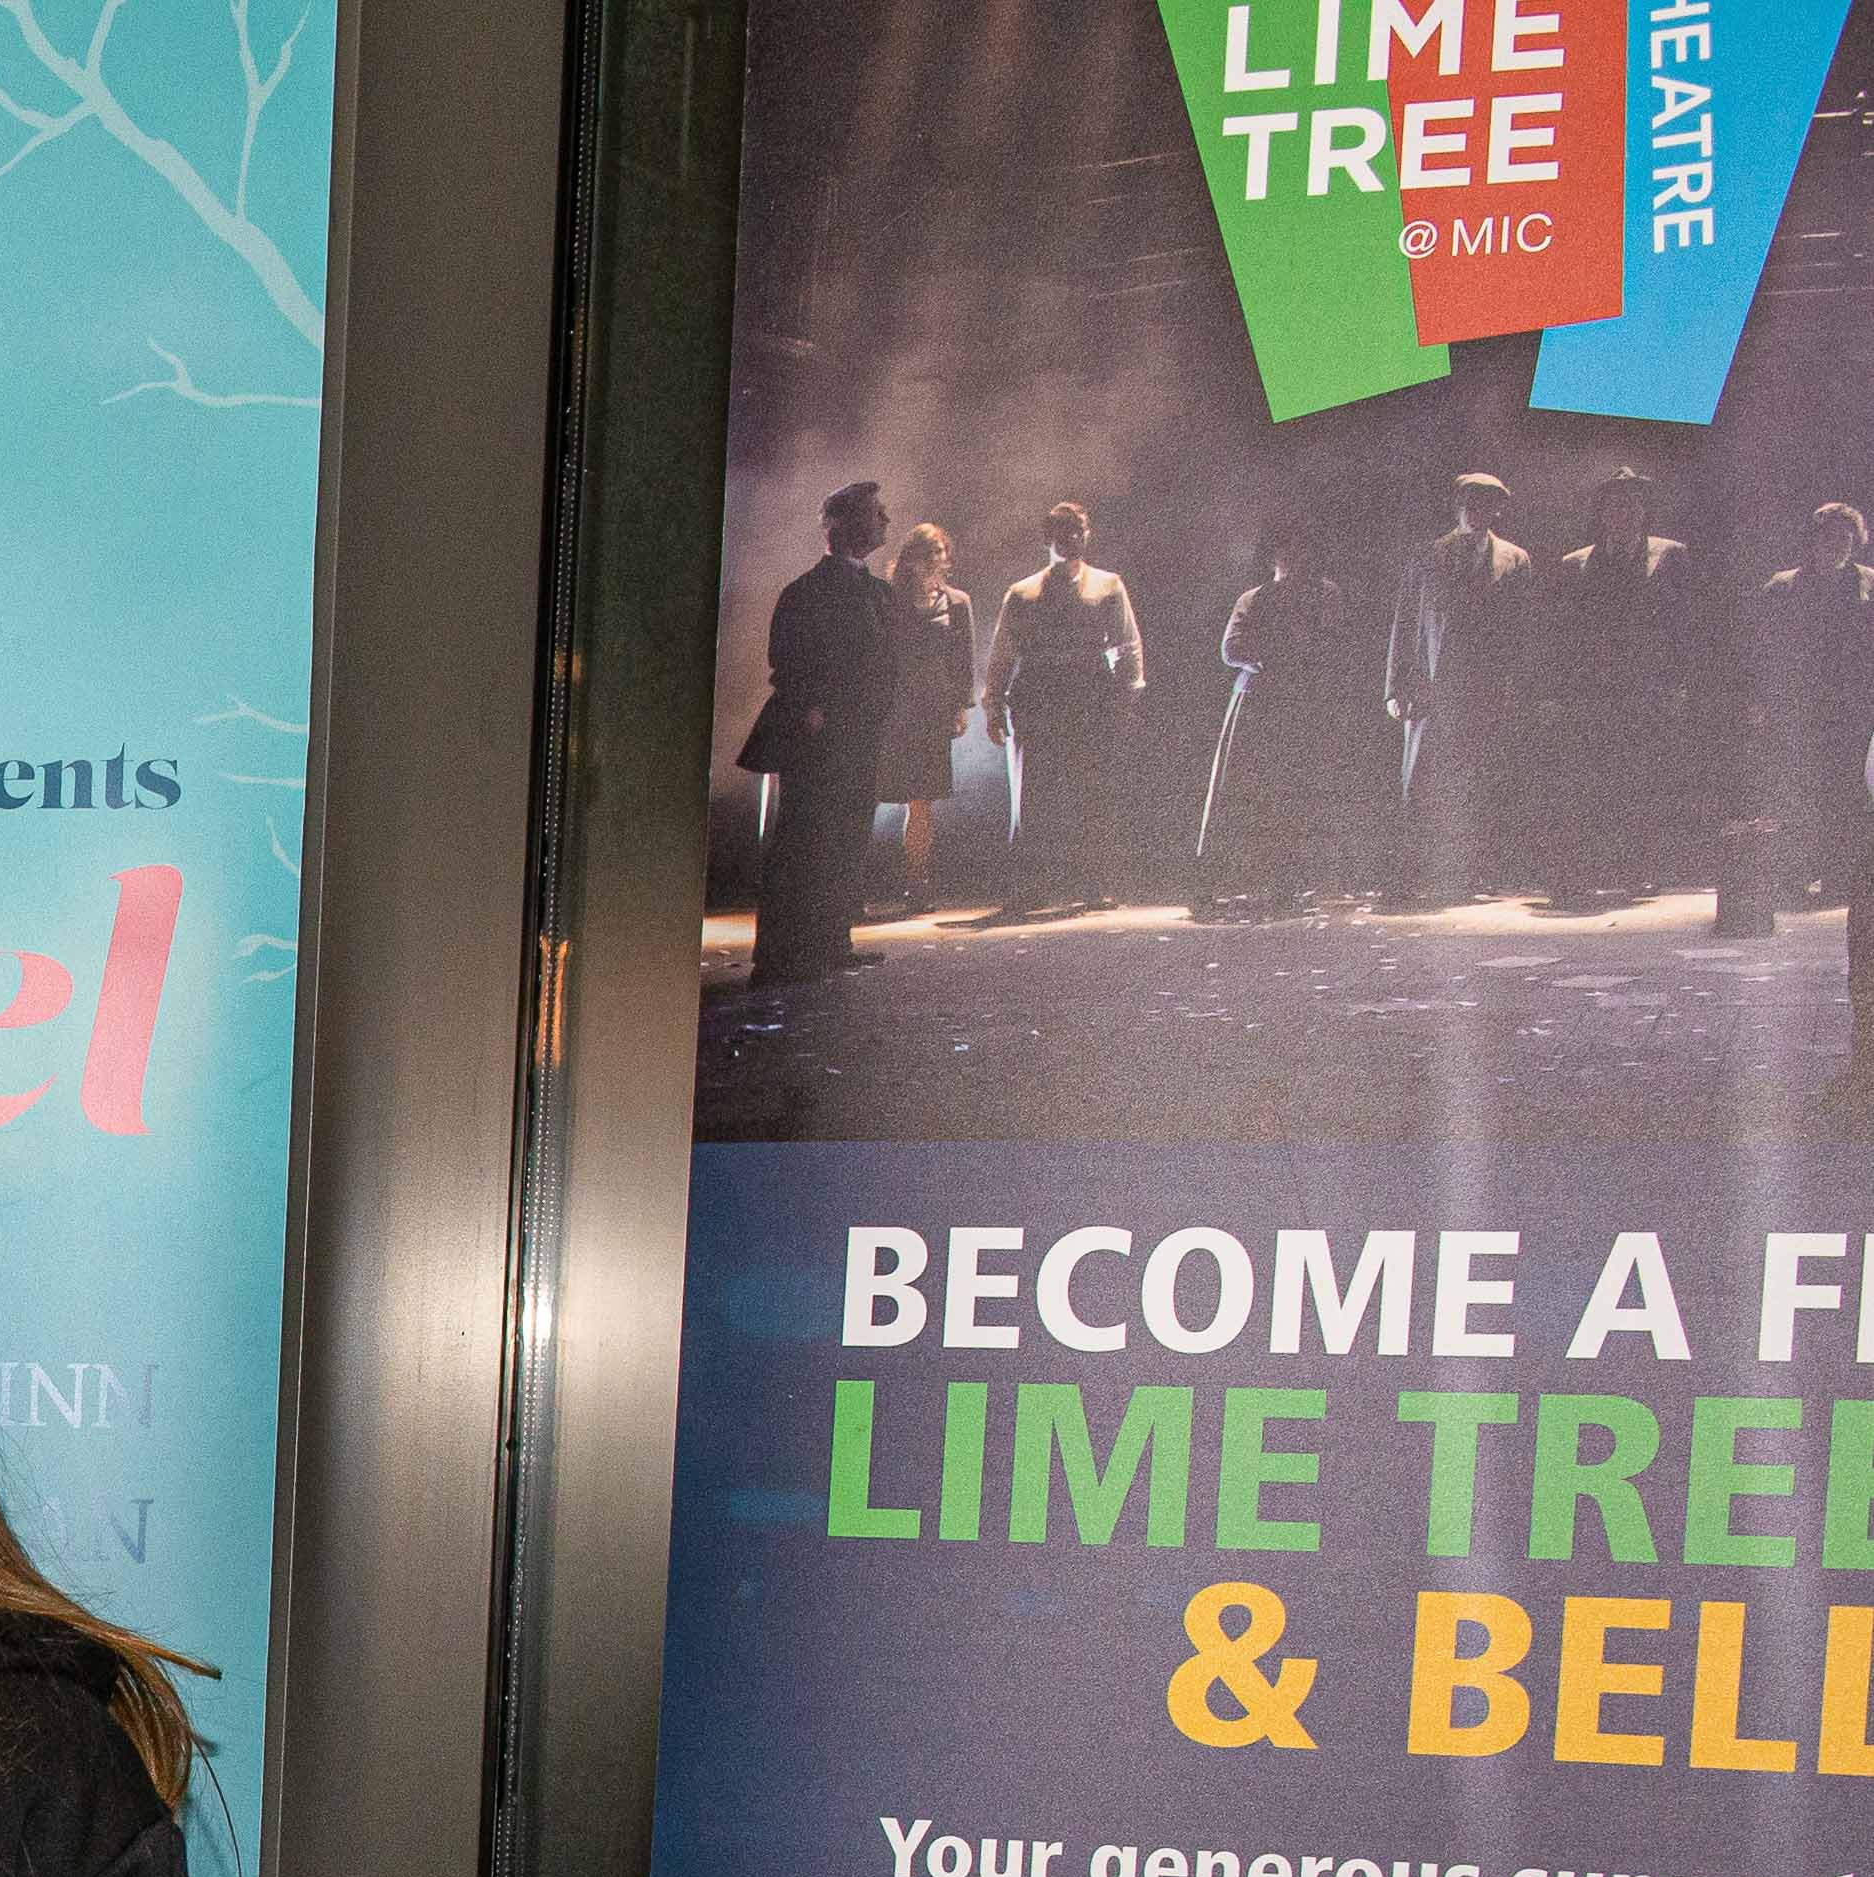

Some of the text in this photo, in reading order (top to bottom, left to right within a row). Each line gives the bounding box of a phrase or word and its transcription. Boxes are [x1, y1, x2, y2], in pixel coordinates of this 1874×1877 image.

[1223, 0, 1564, 93] LIME
[1222, 92, 1563, 200] TREE
[842, 1226, 1520, 1358] BECOME
[1565, 1232, 1692, 1361] A
[827, 1379, 1326, 1552] LIME
[1166, 1581, 1319, 1751] &
